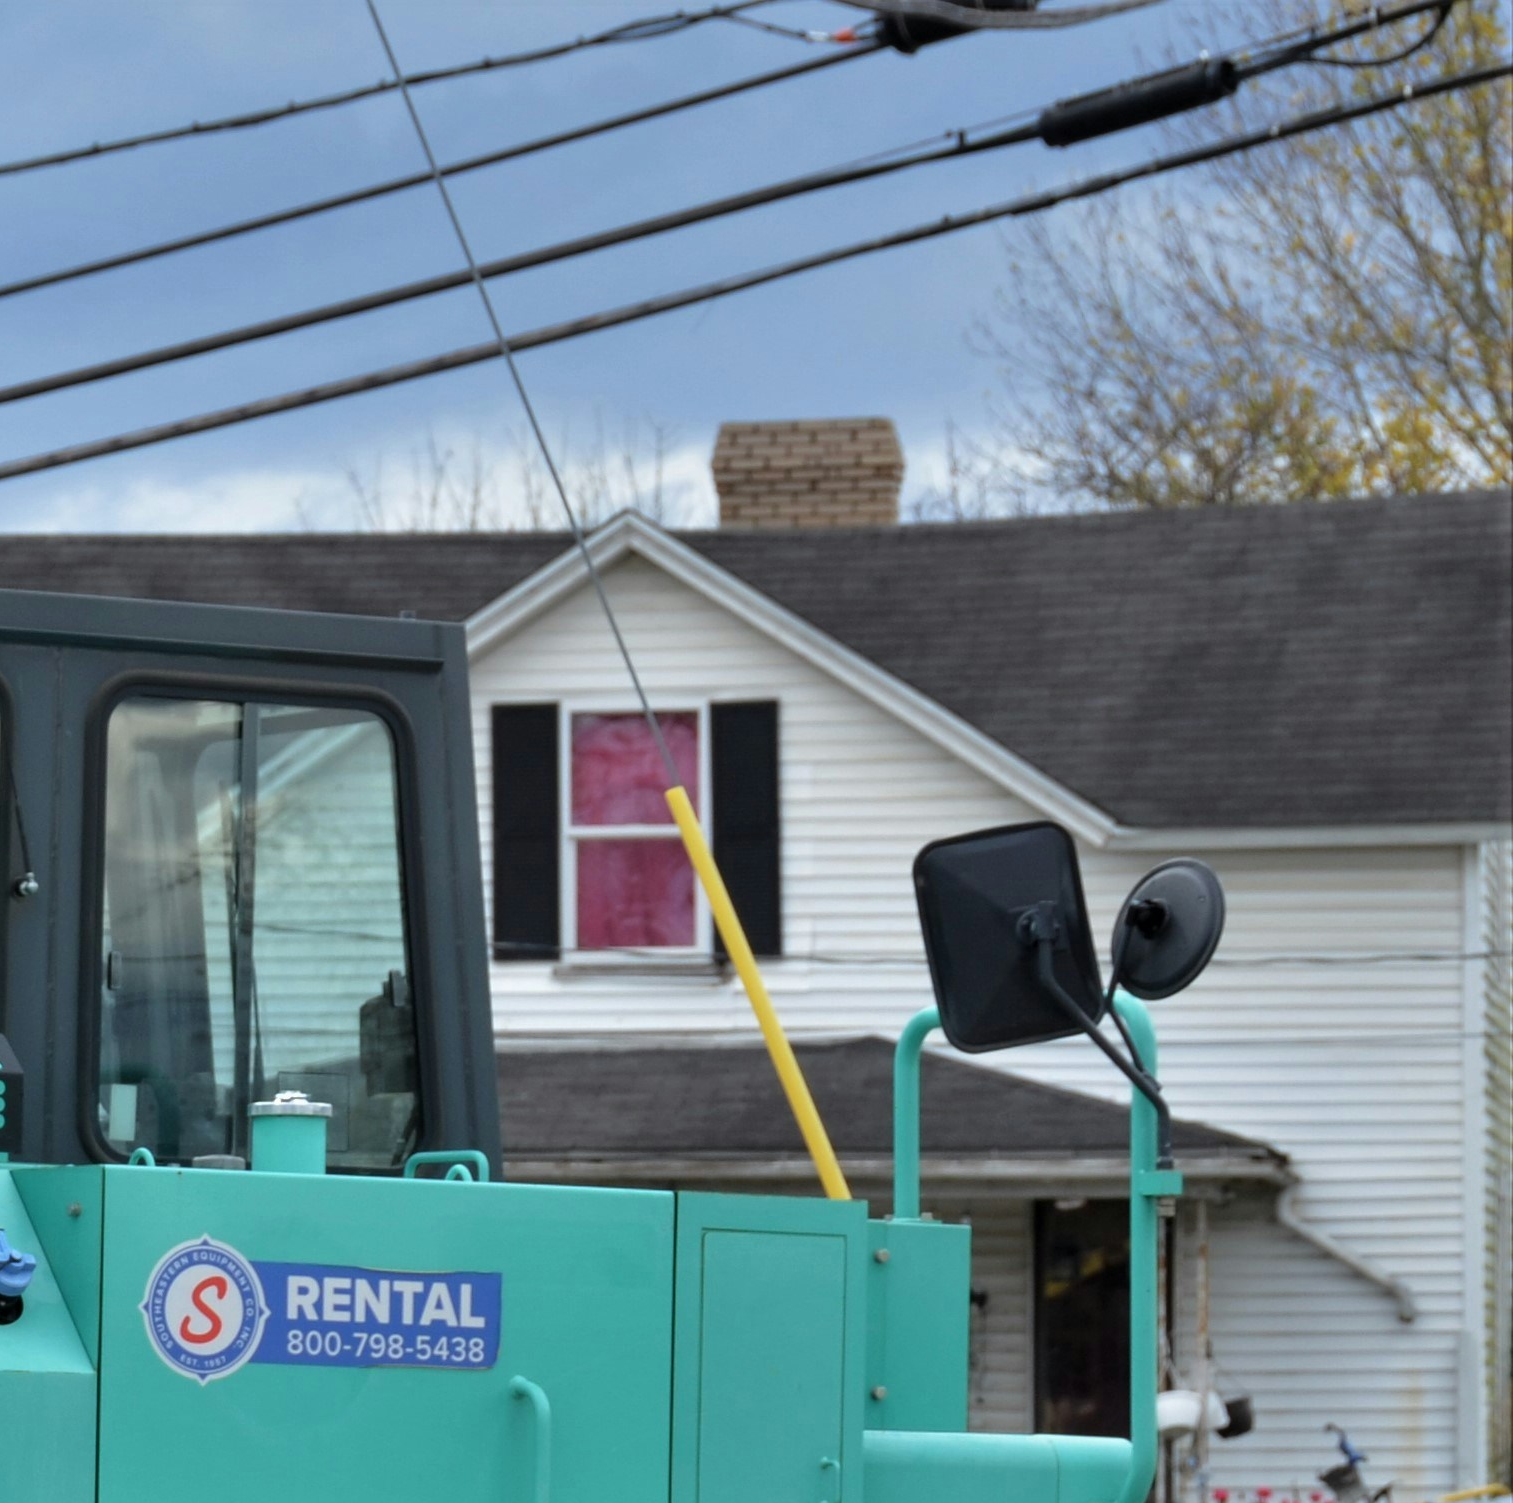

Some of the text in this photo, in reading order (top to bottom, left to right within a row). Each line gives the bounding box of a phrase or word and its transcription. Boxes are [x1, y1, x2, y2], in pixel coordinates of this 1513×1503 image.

[153, 1254, 190, 1350] SOUTHEASTERN
[192, 1251, 251, 1293] EQUIPMENT
[179, 1275, 228, 1345] S
[286, 1274, 486, 1329] RENTAL
[286, 1328, 485, 1363] 800-798-5438
